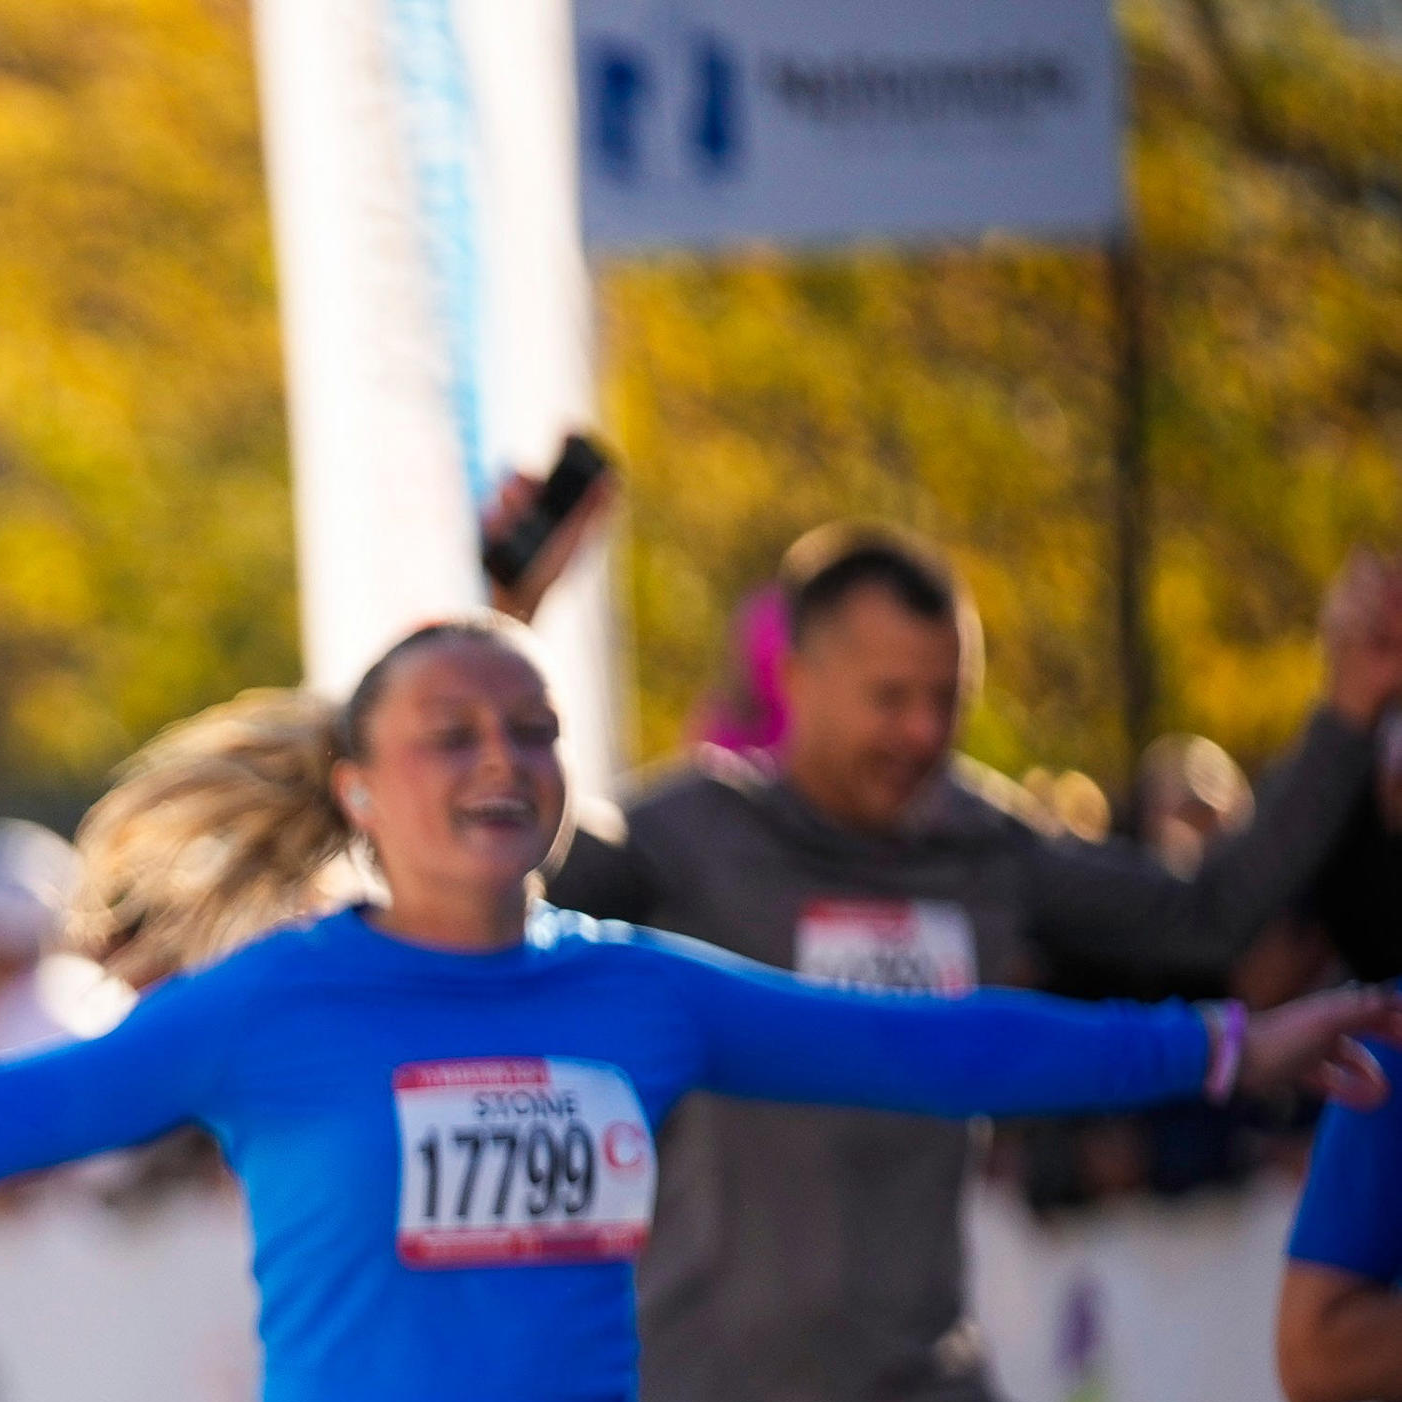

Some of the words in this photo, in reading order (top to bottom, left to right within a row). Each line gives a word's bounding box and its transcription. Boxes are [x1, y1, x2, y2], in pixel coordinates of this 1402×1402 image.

[474, 1089, 580, 1118] STONE
[602, 1121, 646, 1169] C
[418, 1125, 594, 1218] 17799
